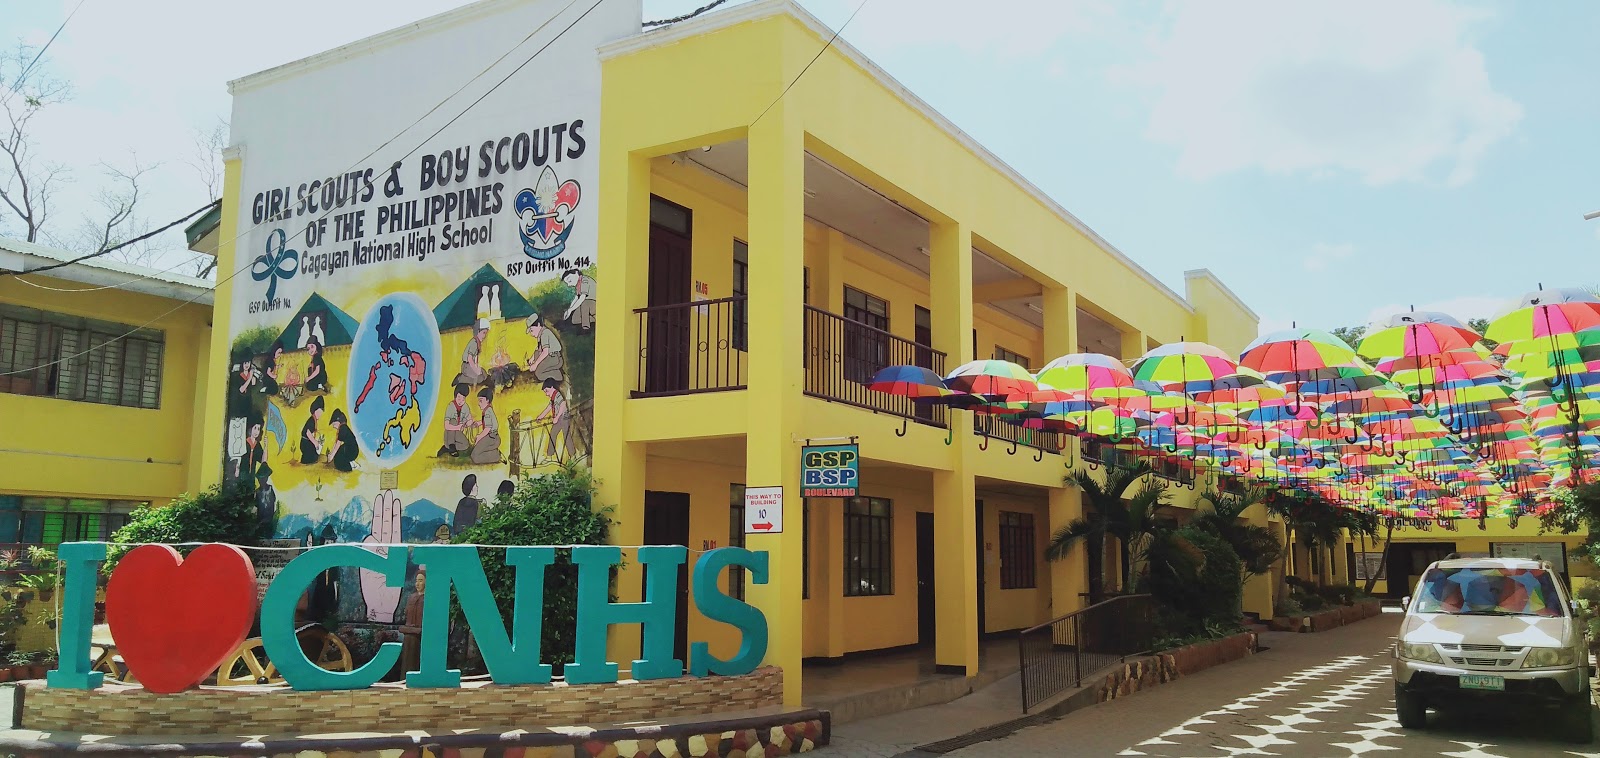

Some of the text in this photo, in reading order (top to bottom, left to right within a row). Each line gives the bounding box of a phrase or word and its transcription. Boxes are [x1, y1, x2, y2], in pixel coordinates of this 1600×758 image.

[252, 119, 587, 225] GIRL SCOUTS & BOY SCOUTS
[305, 182, 505, 249] OF THE PHILIPPINES
[301, 218, 493, 280] Cagayan National High School
[506, 255, 590, 277] BSP Outfit No. 414
[248, 300, 261, 314] GSP
[804, 450, 856, 469] GSP
[804, 468, 857, 486] BSP
[804, 488, 856, 497] BOULEVARD
[758, 508, 767, 519] 10
[47, 541, 769, 691] I CNHS
